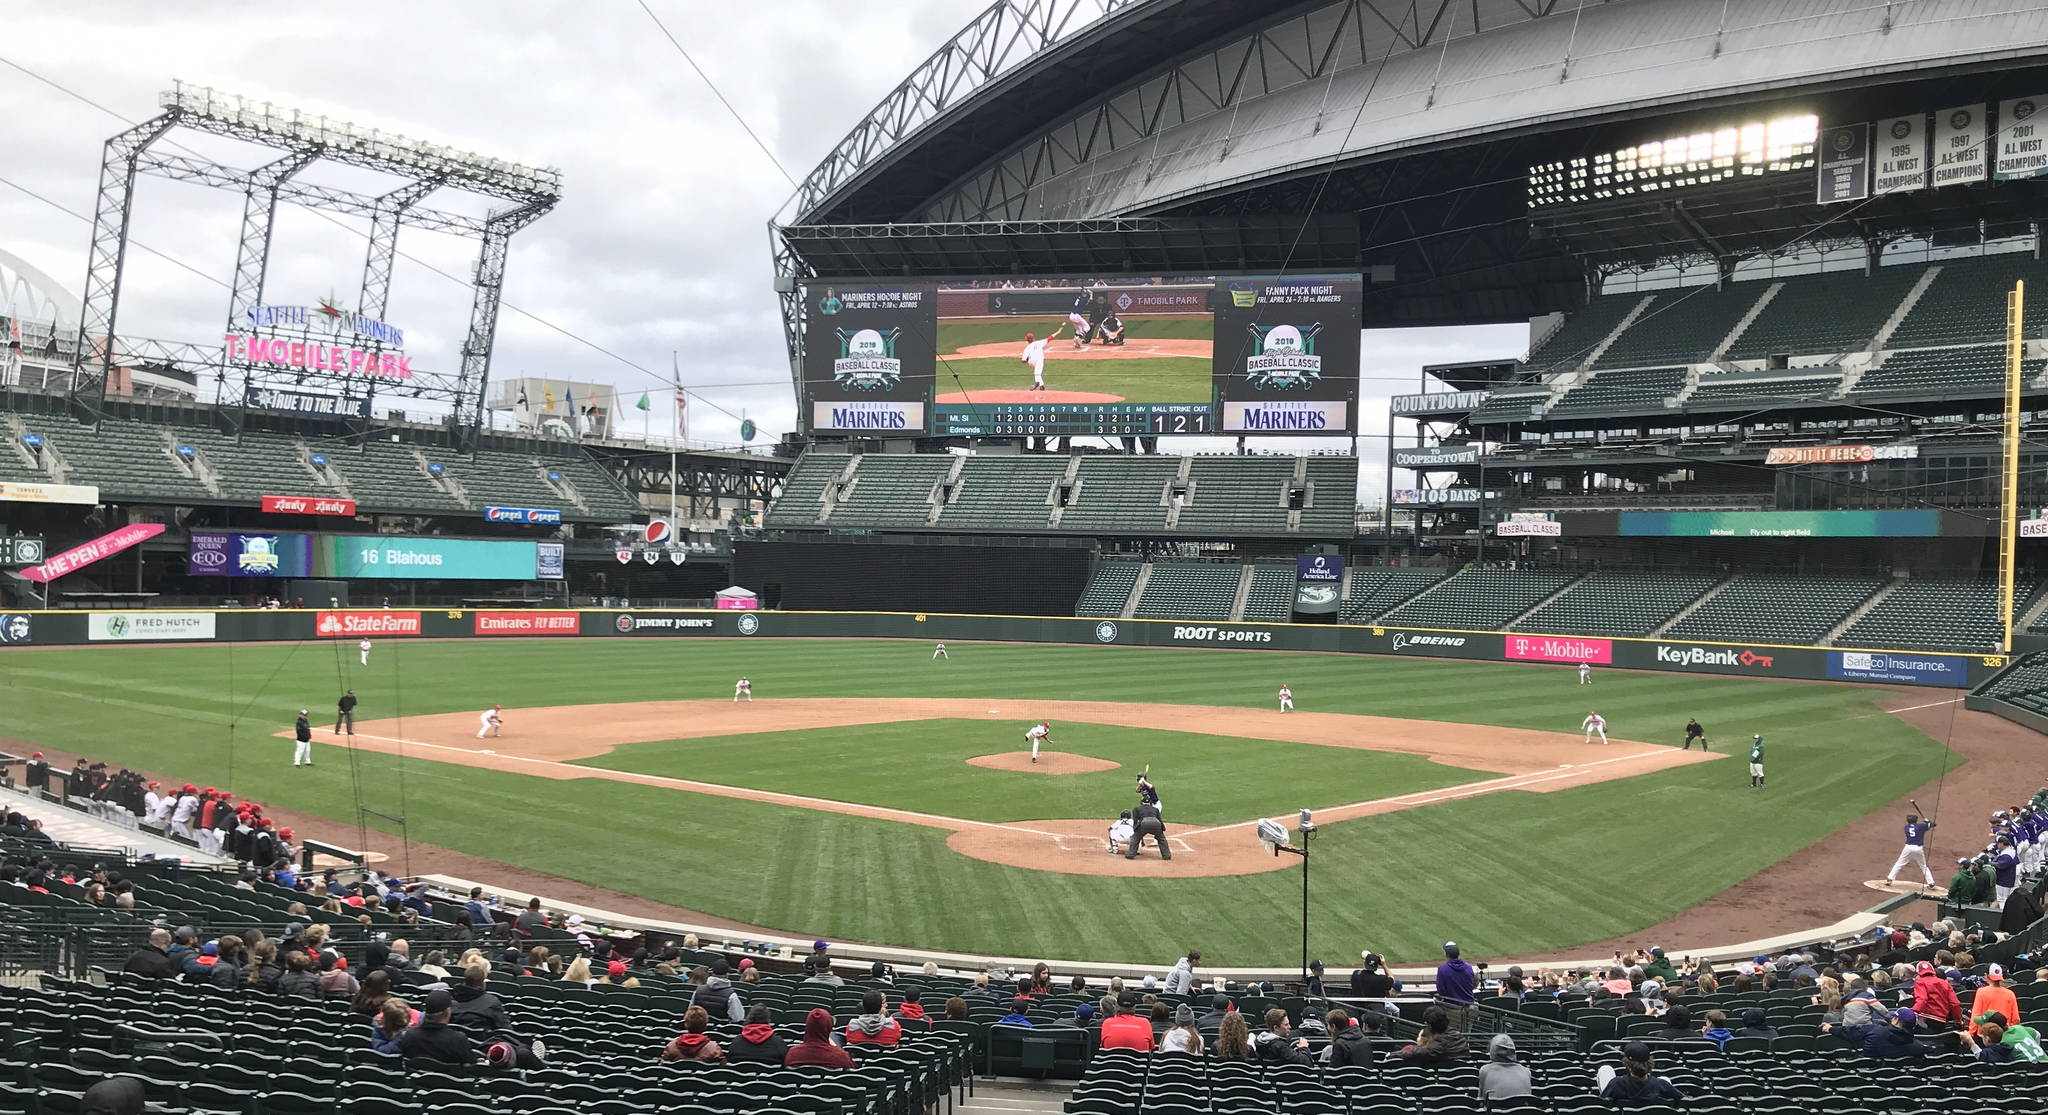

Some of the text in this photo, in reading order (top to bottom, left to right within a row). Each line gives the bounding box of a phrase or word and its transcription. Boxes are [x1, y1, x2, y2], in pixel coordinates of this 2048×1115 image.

[2013, 124, 2034, 138] 2001
[1950, 135, 1970, 148] 1997
[2020, 139, 2043, 152] WEST
[1890, 144, 1911, 158] 1995
[1956, 149, 1979, 162] WEST
[1896, 158, 1919, 171] WEST
[1998, 154, 2047, 172] CHAMPIONS
[1936, 164, 1983, 182] CHAMPIONS
[1878, 174, 1922, 190] CHAMPIONS
[842, 292, 922, 302] MARINERS HOODIE NIGHT
[1266, 286, 1334, 296] FANNY PACK NIGHT
[1176, 296, 1198, 304] PARK
[246, 305, 404, 347] SEATTLE MARINERS
[224, 334, 414, 380] T-MOBILE PARK
[836, 360, 899, 371] BASEBALL CLASSIC
[1248, 358, 1320, 370] BASEBALL CLASSIC
[271, 390, 298, 411] TRUE
[300, 395, 313, 412] TO
[314, 396, 334, 413] THE
[1392, 392, 1481, 412] COUNTDOWN
[832, 408, 906, 428] MARINERS
[1156, 415, 1203, 432] 1 2 1
[1244, 408, 1326, 429] MARINERS
[1396, 450, 1476, 464] COOPERSTOWN
[1796, 450, 1814, 461] HIT
[1816, 449, 1826, 460] IT
[1830, 448, 1856, 460] HERE
[1420, 489, 1477, 502] 105 DAYS
[1499, 524, 1559, 534] BASEBALL CLASSIC
[1710, 528, 1734, 536] Michael
[1750, 528, 1760, 536] Fly
[1796, 528, 1811, 536] field
[192, 536, 228, 544] EMERALD
[198, 542, 222, 550] QUEEN
[360, 550, 443, 566] 16 Blahous
[540, 548, 560, 556] BUILT
[37, 559, 69, 579] THE
[540, 566, 560, 574] TOUGH
[136, 619, 163, 627] FRED
[166, 618, 200, 626] HUTCH
[480, 618, 575, 629] Emirates FLY BETTER
[636, 619, 714, 629] JIMMY JOHN'S
[1174, 626, 1272, 642] ROOT SPORTS
[1409, 635, 1466, 646] BOEING
[1657, 646, 1739, 666] KeyBank
[1983, 656, 2002, 667] 326
[1846, 655, 1945, 672] Safeco Insurance
[1889, 673, 1916, 681] Company
[1908, 827, 1916, 837] 5
